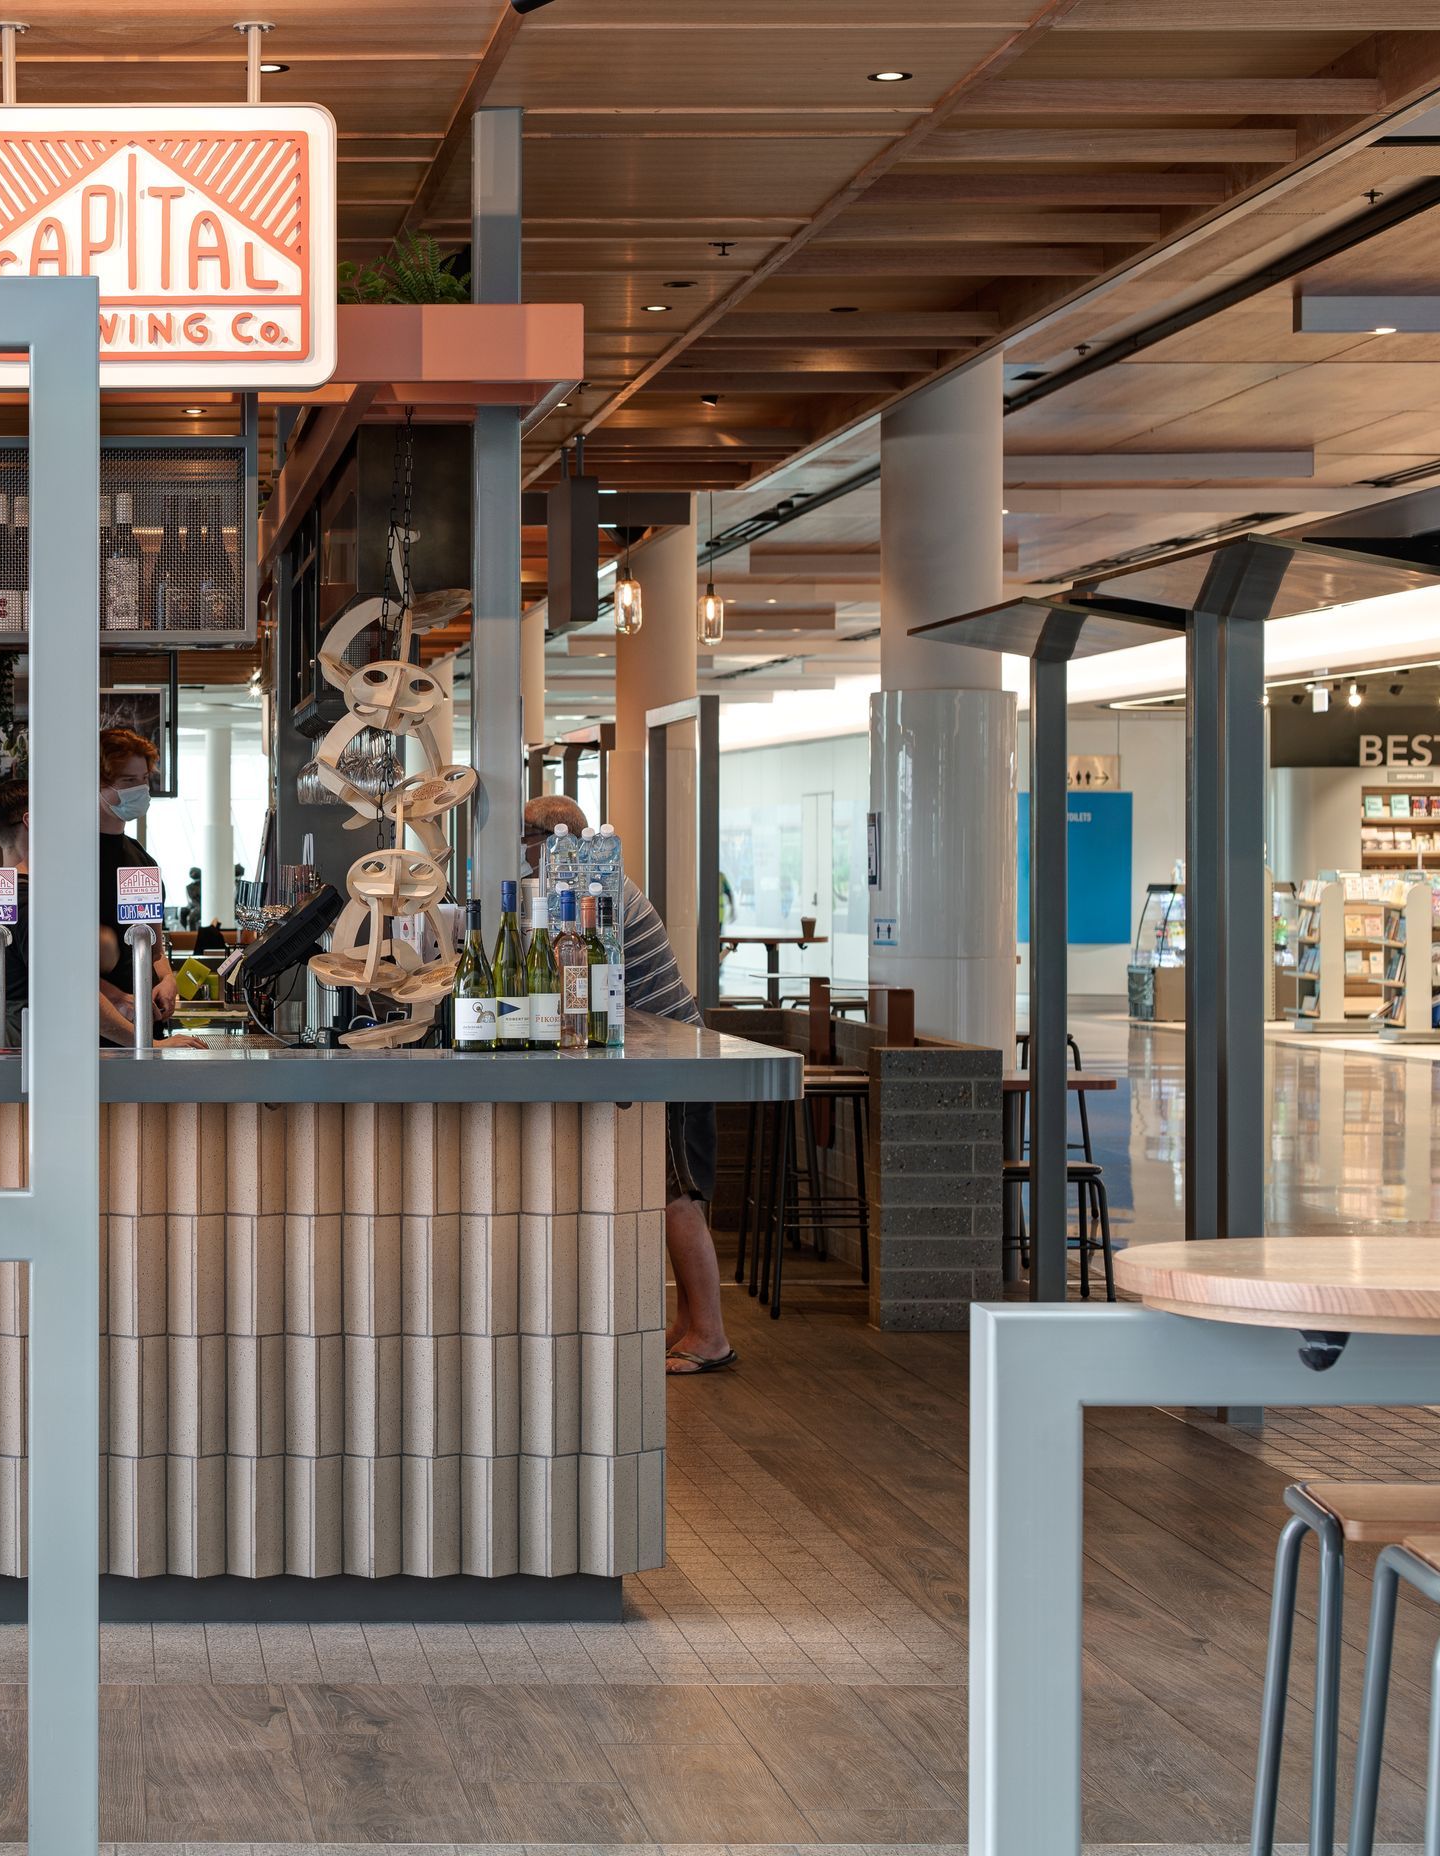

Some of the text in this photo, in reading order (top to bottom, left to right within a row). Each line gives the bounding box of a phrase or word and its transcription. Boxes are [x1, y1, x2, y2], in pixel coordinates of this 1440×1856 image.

[231, 312, 289, 344] Co.
[123, 871, 155, 888] CAPITAL
[145, 904, 160, 918] ALE
